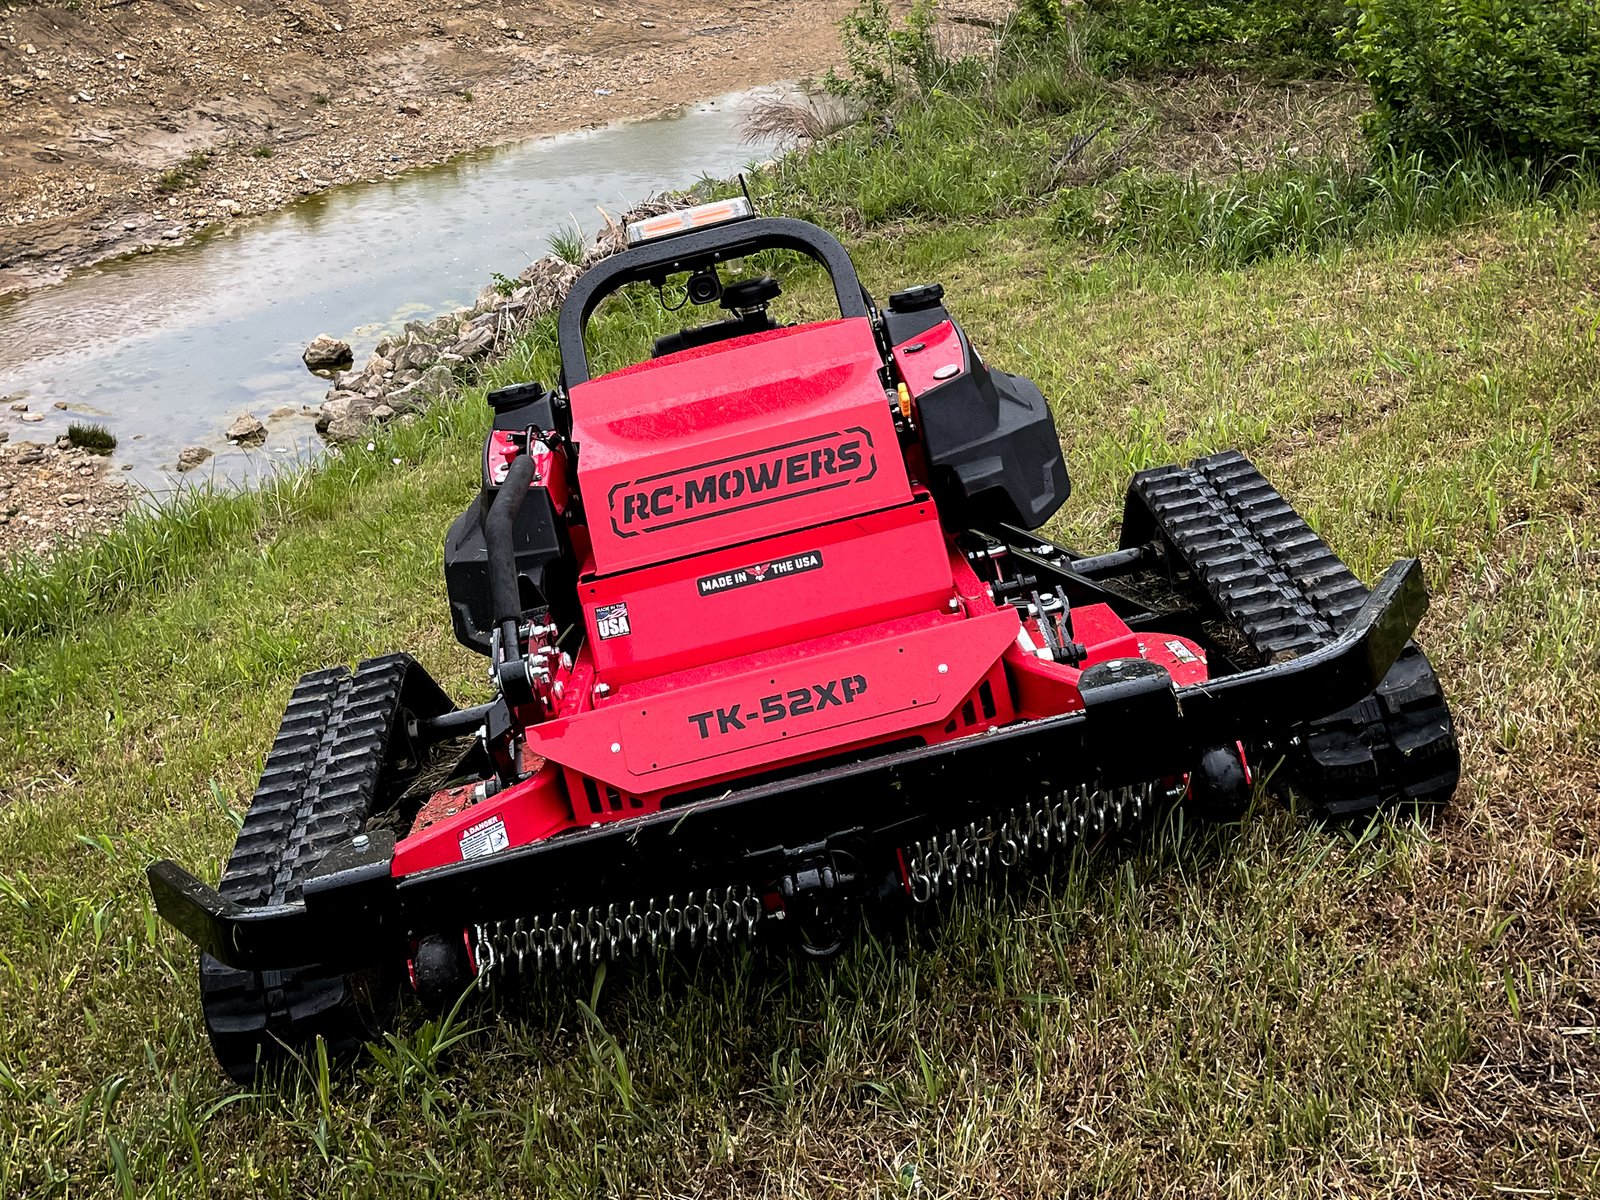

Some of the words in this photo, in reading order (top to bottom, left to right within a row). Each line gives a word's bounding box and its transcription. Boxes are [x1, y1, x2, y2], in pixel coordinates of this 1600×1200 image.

[685, 441, 863, 510] MOWERS
[701, 575, 733, 592] MADE
[734, 572, 747, 583] IN
[771, 560, 794, 574] THE
[795, 555, 818, 569] USA
[598, 616, 630, 638] USA
[688, 674, 868, 739] TK-52XP
[469, 815, 499, 835] DANGER
